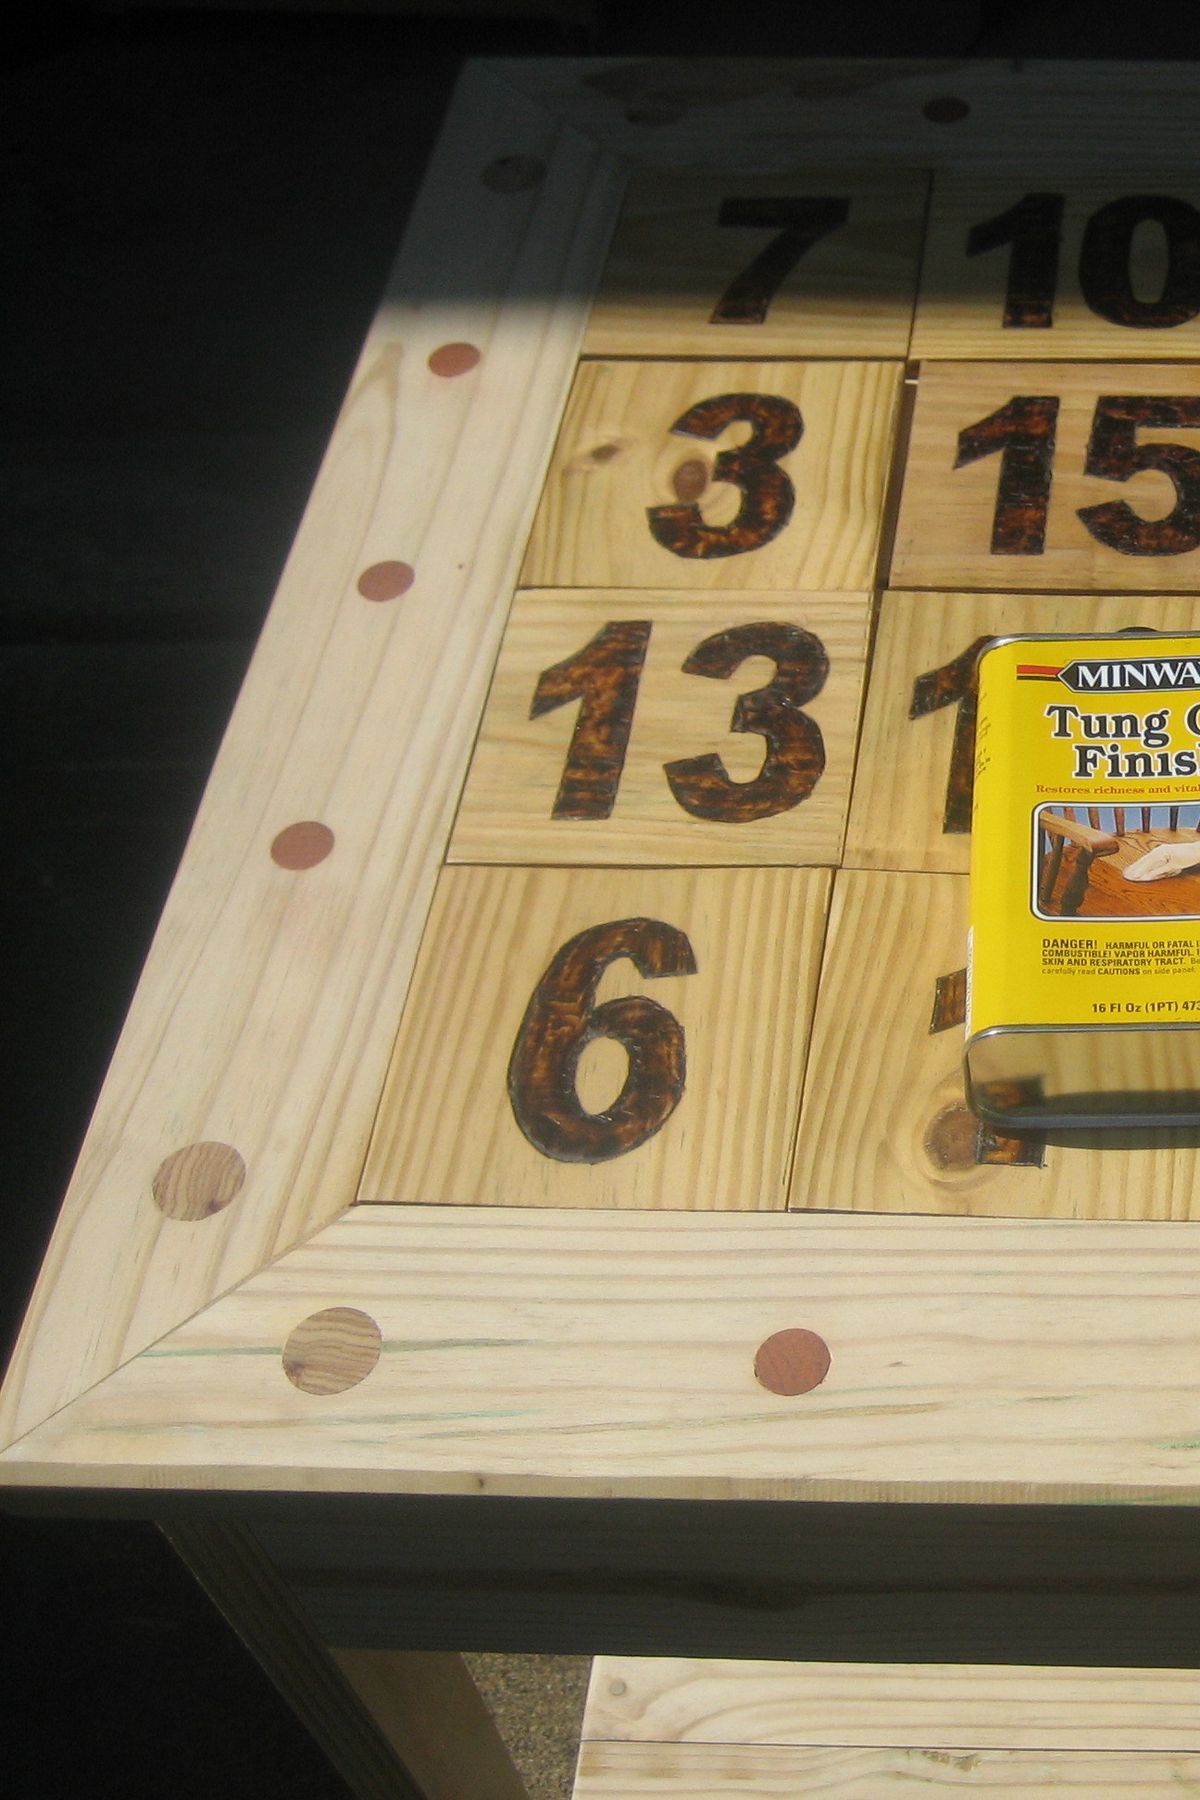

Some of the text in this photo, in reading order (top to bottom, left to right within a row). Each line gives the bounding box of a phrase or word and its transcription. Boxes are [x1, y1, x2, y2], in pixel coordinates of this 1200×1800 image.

[709, 198, 850, 325] 7
[646, 392, 804, 560] 3
[529, 620, 830, 823] 13
[1047, 705, 1169, 747] Tung
[1036, 784, 1090, 794] Restores
[1094, 786, 1145, 794] richness
[1148, 785, 1171, 793] and
[1042, 938, 1098, 949] DANGER!
[1105, 942, 1150, 950] HARMFUL
[1152, 941, 1165, 949] OR
[1167, 940, 1194, 949] FATAL
[1042, 949, 1112, 958] COMBUSTIBLE!
[1114, 950, 1146, 958] VAPOR
[1042, 958, 1064, 966] SKIN
[1066, 958, 1087, 966] AND
[1090, 958, 1152, 967] RESPIRATORY
[1042, 967, 1076, 976] carefully
[1097, 968, 1141, 976] CAUTIONS
[1154, 967, 1171, 975] side
[1092, 1003, 1107, 1013] 16
[1125, 1003, 1142, 1013] Oz
[1145, 1001, 1179, 1014] (1PT)
[507, 917, 697, 1164] 6
